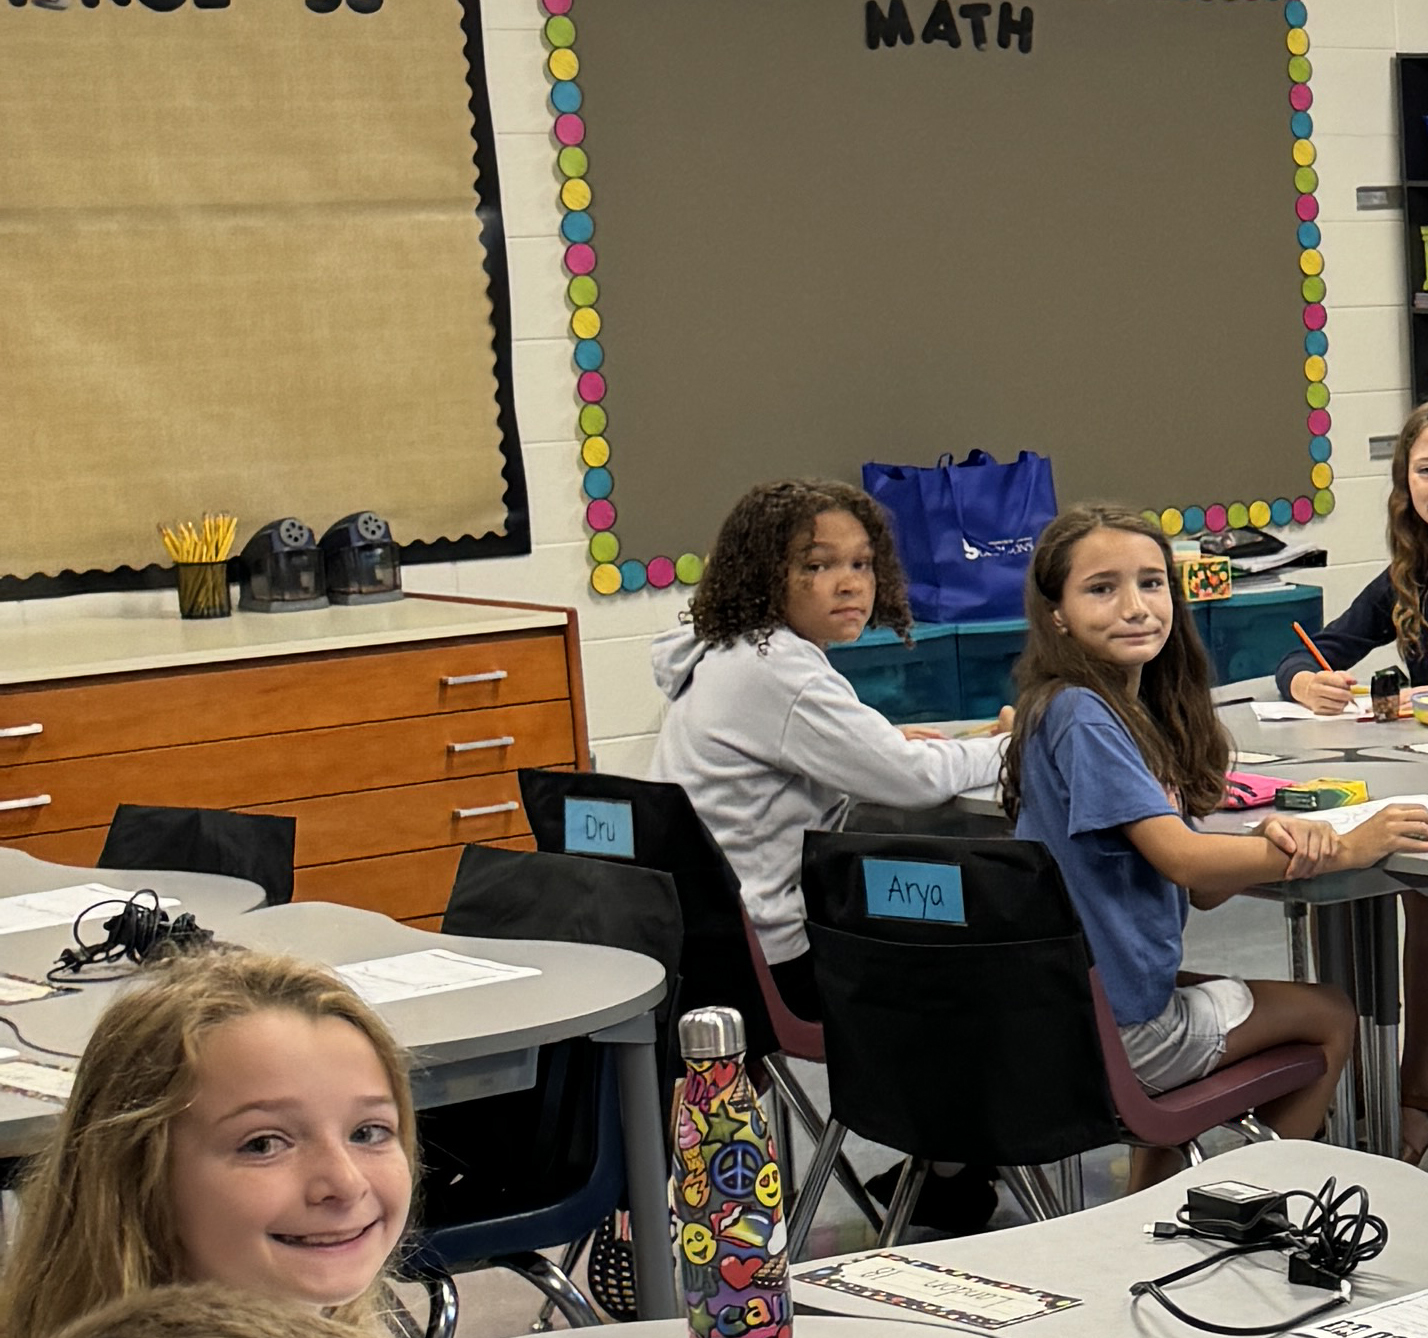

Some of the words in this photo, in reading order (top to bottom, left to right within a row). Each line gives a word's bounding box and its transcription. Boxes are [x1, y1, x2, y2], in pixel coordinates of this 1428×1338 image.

[865, 0, 1034, 54] MATH
[585, 814, 616, 842] Dru
[888, 874, 945, 919] Arya
[923, 1278, 1015, 1309] Landon
